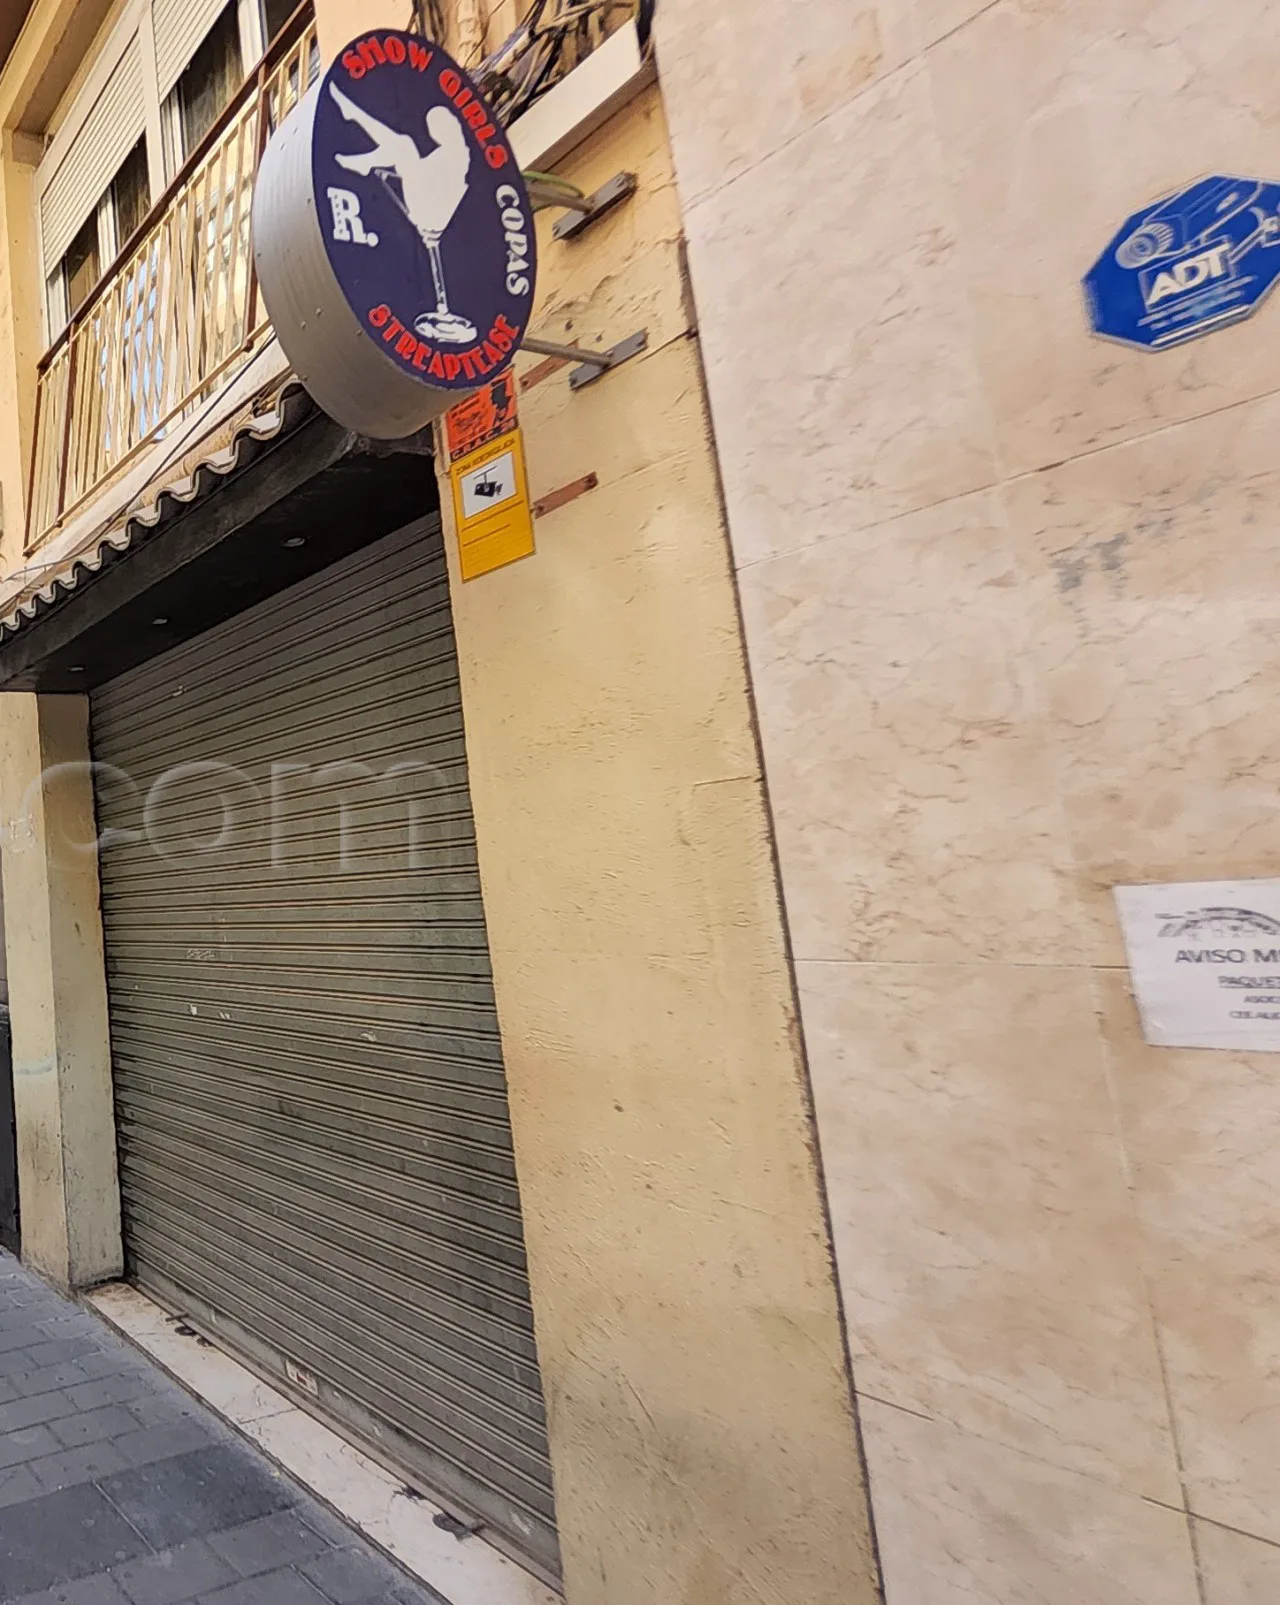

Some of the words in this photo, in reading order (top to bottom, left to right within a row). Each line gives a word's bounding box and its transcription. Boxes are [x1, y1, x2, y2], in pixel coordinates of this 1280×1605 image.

[438, 67, 509, 169] GIRLS
[326, 187, 380, 248] R.
[495, 184, 530, 297] COPAS
[1147, 243, 1231, 305] ADT
[367, 303, 520, 381] STREAPTEASE
[1175, 949, 1246, 963] AVISO
[1252, 948, 1280, 963] M
